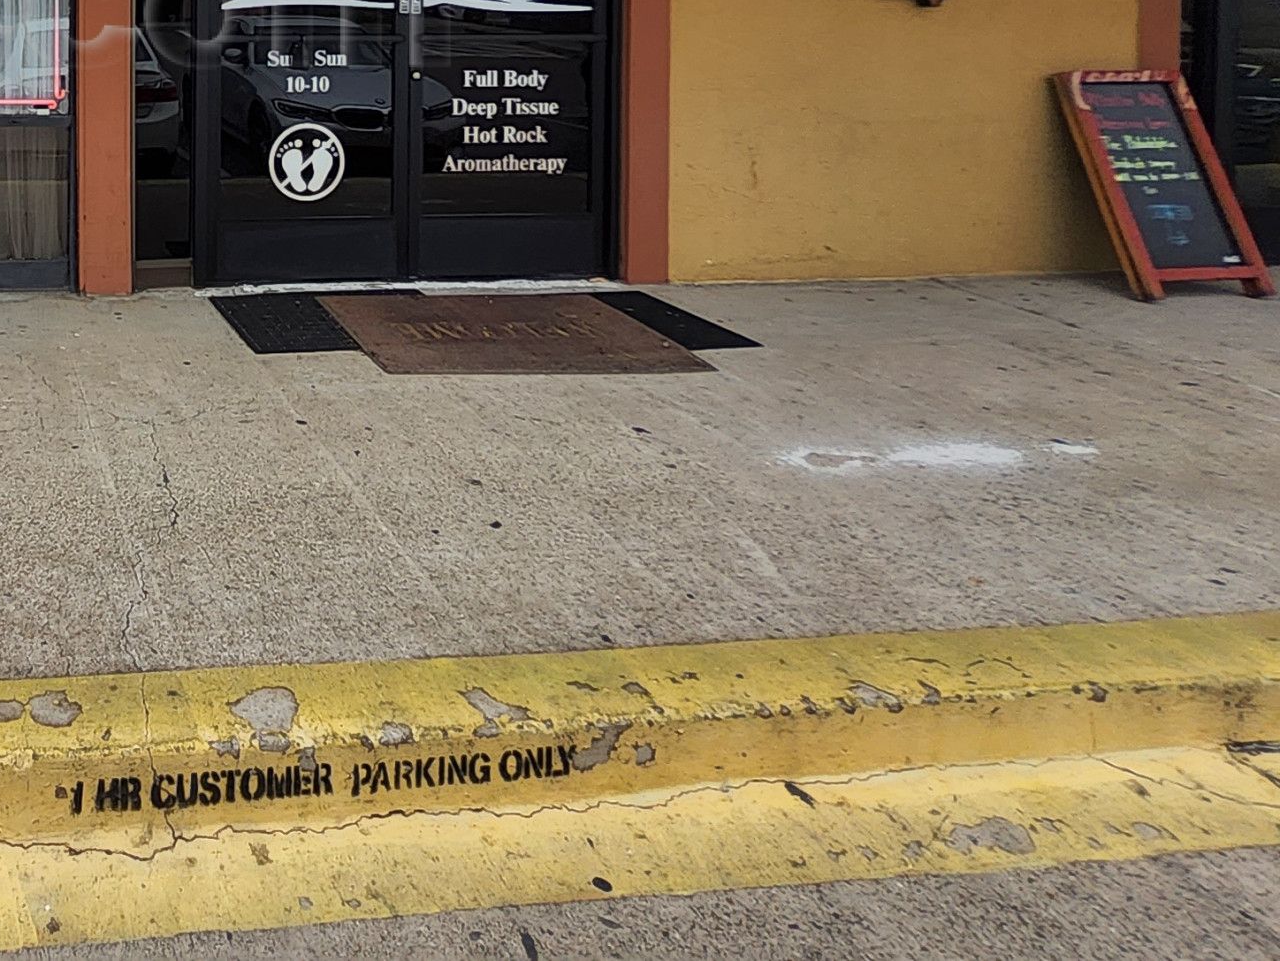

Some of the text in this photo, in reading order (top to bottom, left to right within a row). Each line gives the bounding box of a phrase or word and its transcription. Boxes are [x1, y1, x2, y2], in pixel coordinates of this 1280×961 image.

[314, 50, 347, 67] Sun
[285, 76, 330, 93] 10-10
[463, 69, 549, 91] Full Body
[451, 98, 559, 119] Deep Tissue
[463, 125, 548, 144] Hot Rock
[441, 155, 567, 176] Aromatherapy
[95, 777, 142, 812] HR
[150, 762, 334, 810] CUSTOMER
[351, 751, 491, 797] PARKING
[498, 745, 578, 783] ONLY
